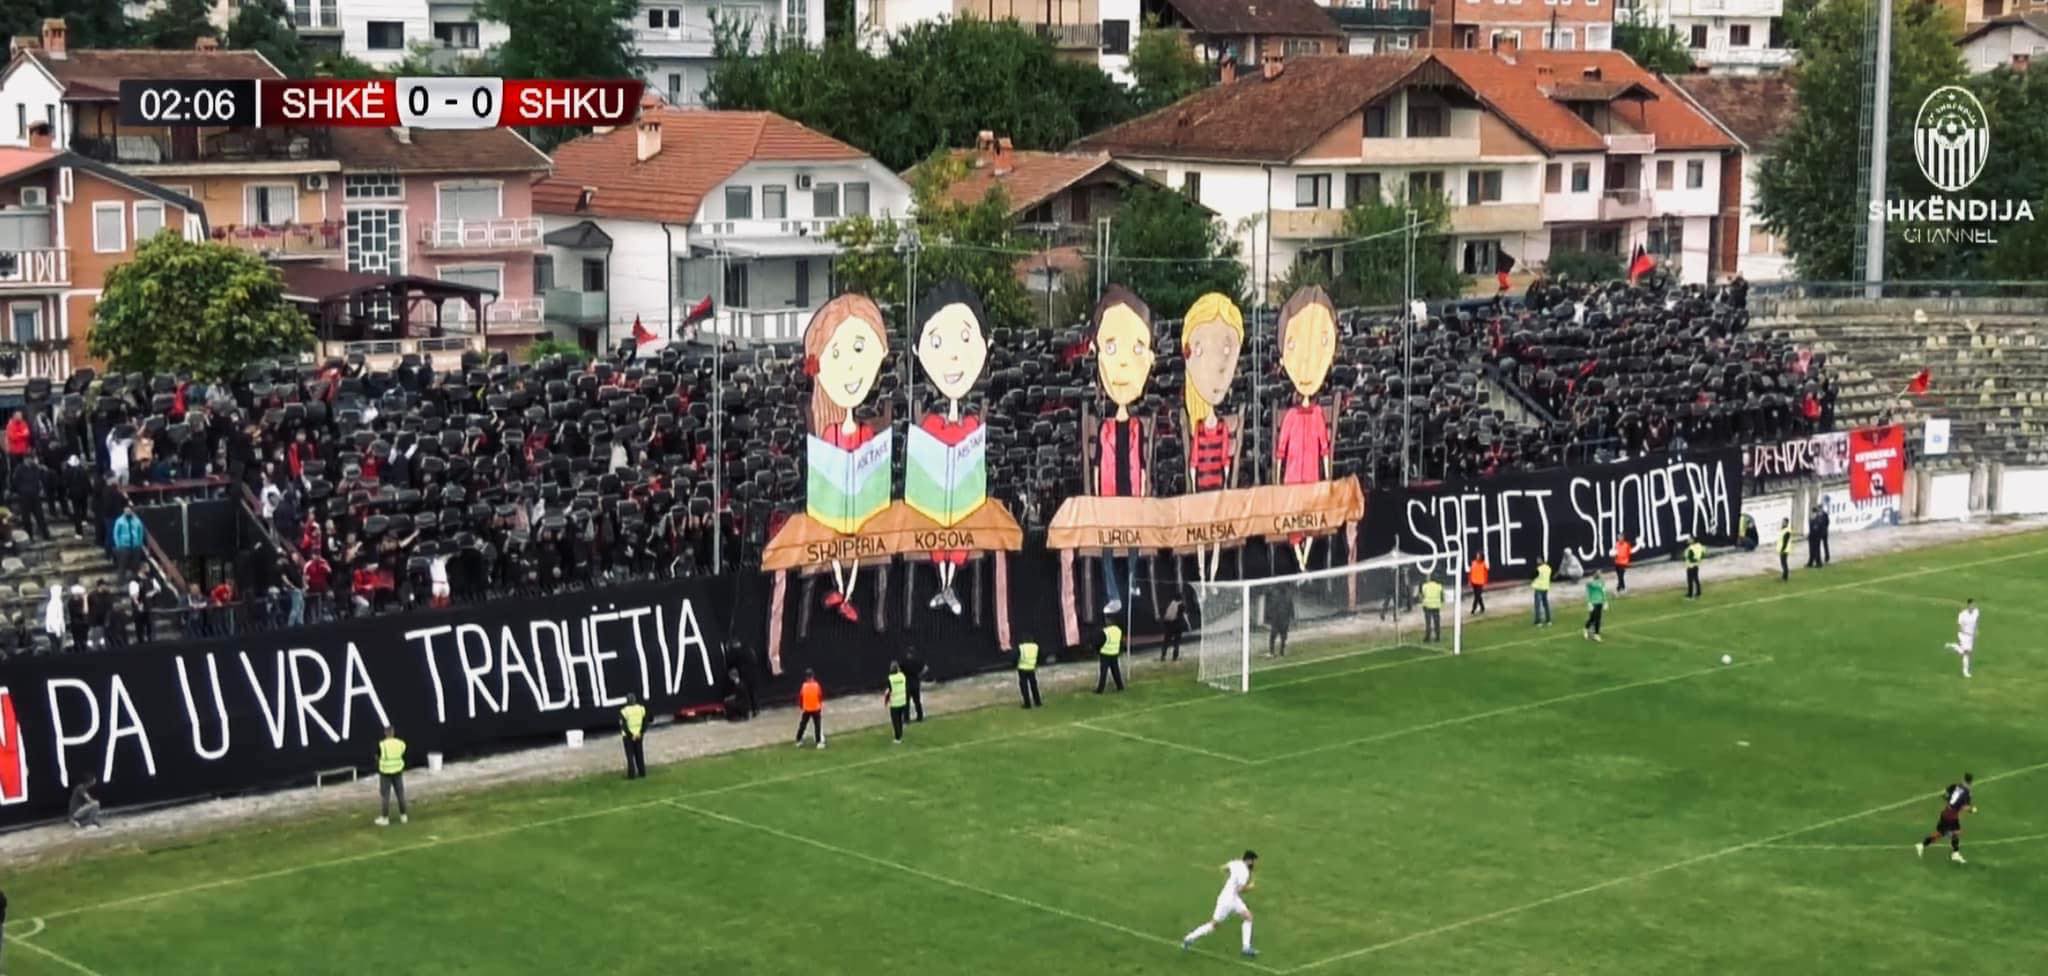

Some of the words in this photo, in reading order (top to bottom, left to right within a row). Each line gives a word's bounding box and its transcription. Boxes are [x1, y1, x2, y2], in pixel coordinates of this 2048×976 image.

[914, 531, 975, 549] KOSOVA
[1407, 485, 1552, 576] S'BËHET
[1569, 454, 1731, 561] SHQIPËRIA
[47, 674, 156, 788] PA
[175, 652, 230, 759] U
[239, 641, 390, 749] VRA
[404, 598, 715, 724] TRADHËTIA
